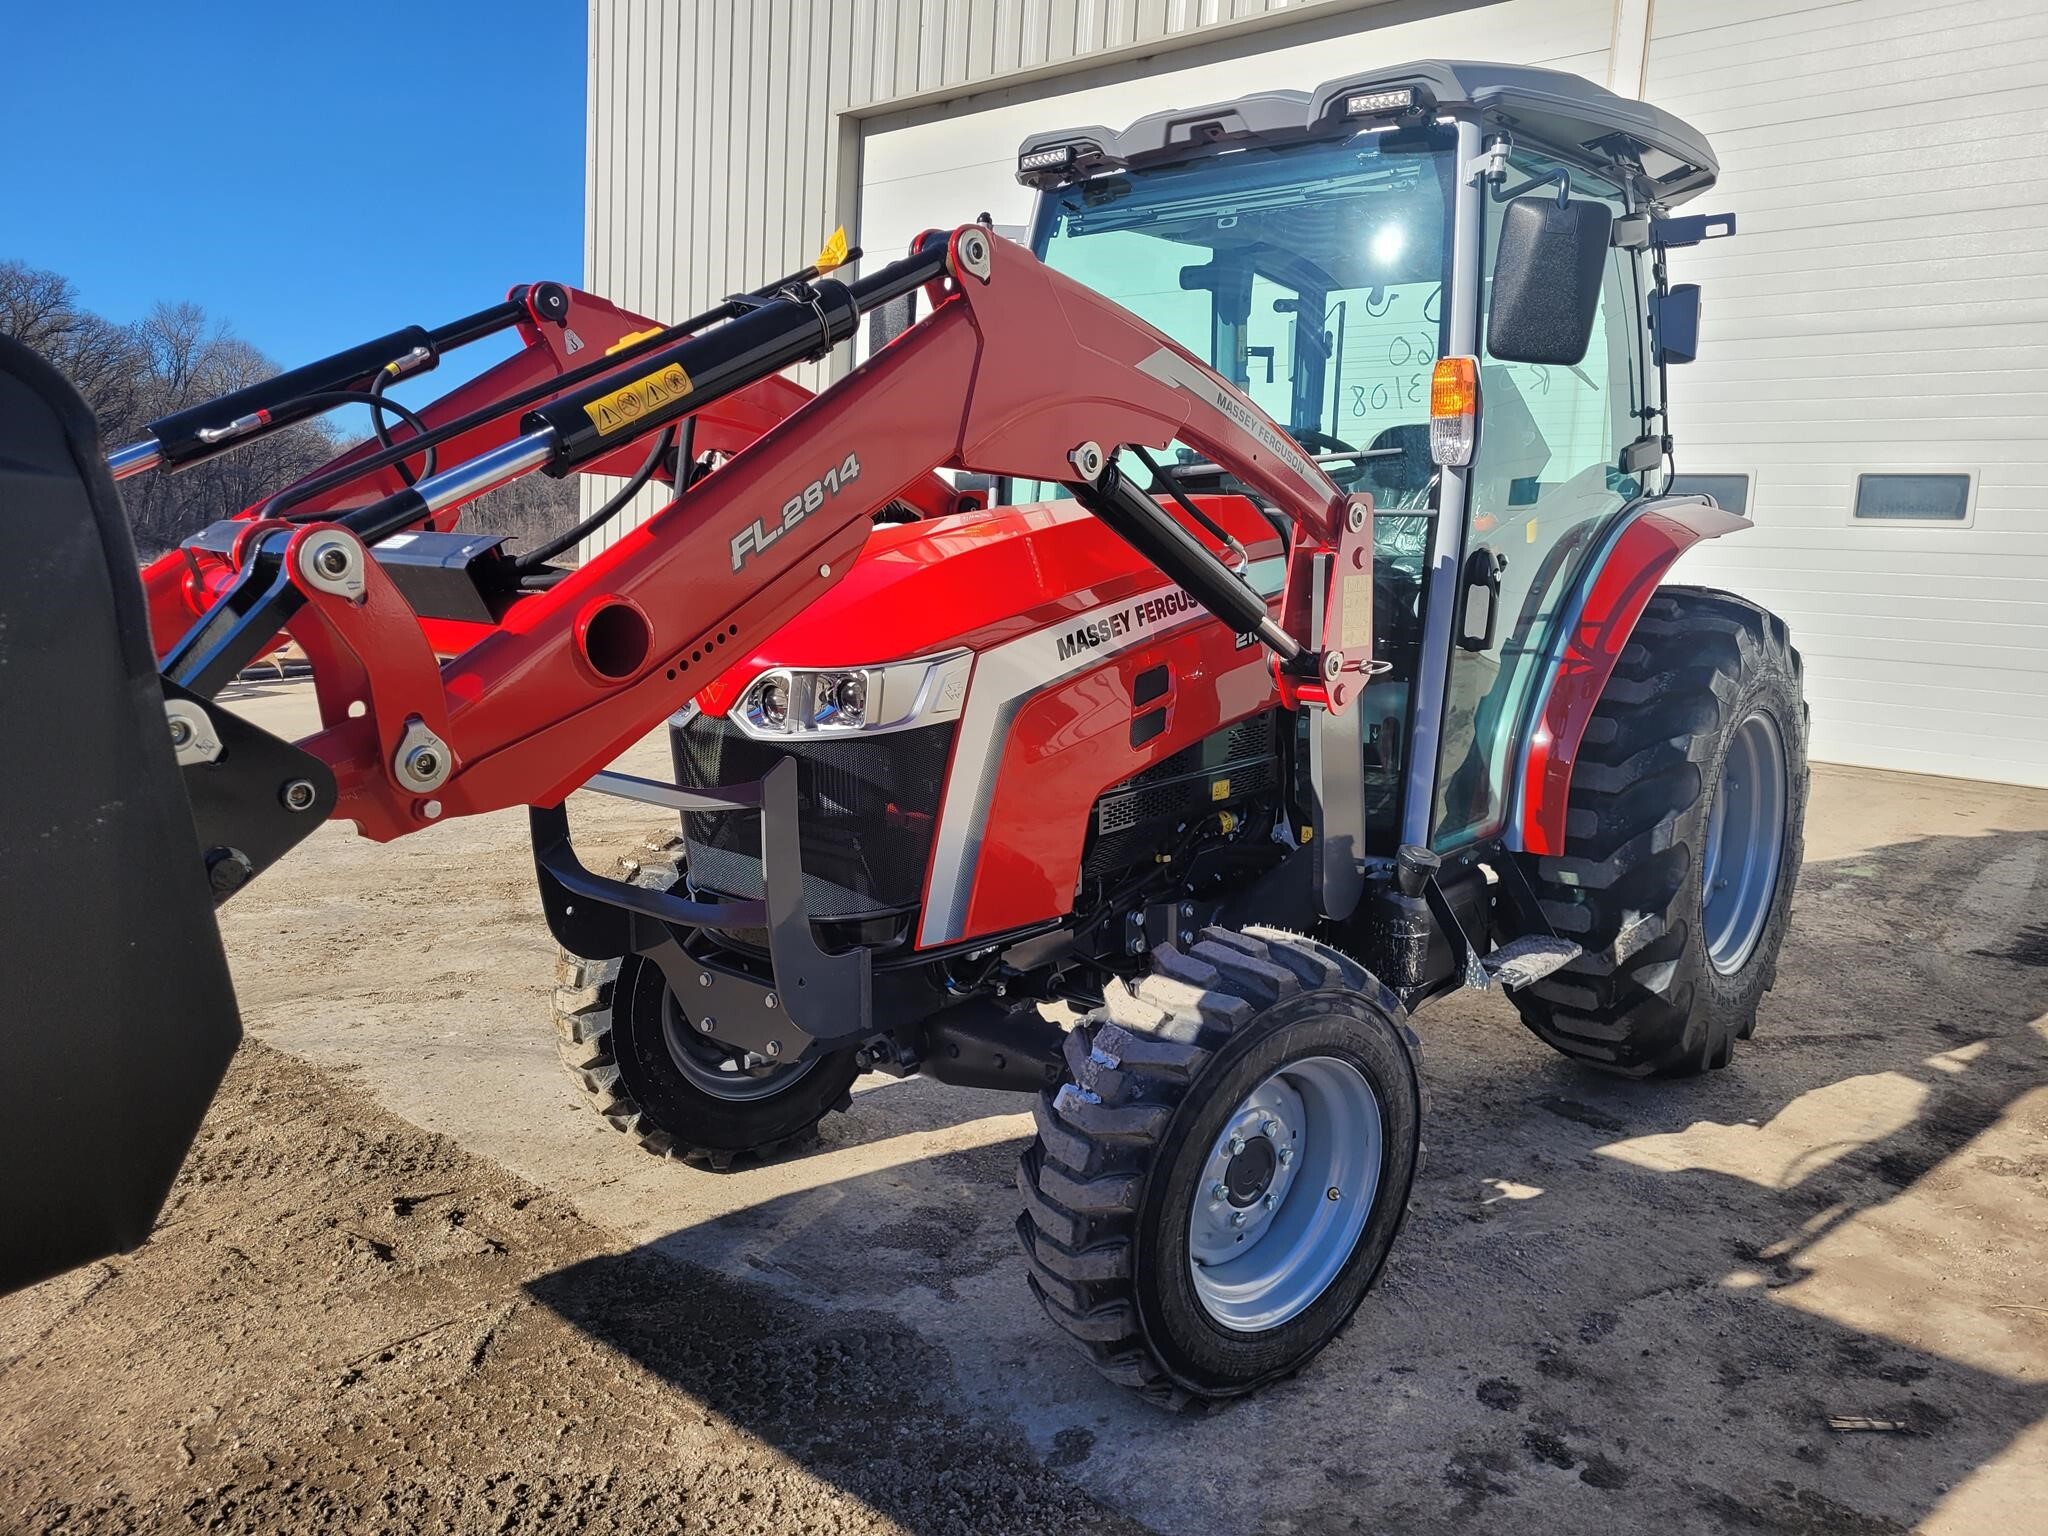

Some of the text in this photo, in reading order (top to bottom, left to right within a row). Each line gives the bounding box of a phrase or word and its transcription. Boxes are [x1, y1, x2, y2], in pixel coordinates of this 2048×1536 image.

[1217, 391, 1306, 474] MASSEY FERGUSON
[729, 452, 861, 573] FL.2814
[1056, 590, 1199, 662] MASSEY FERGUS
